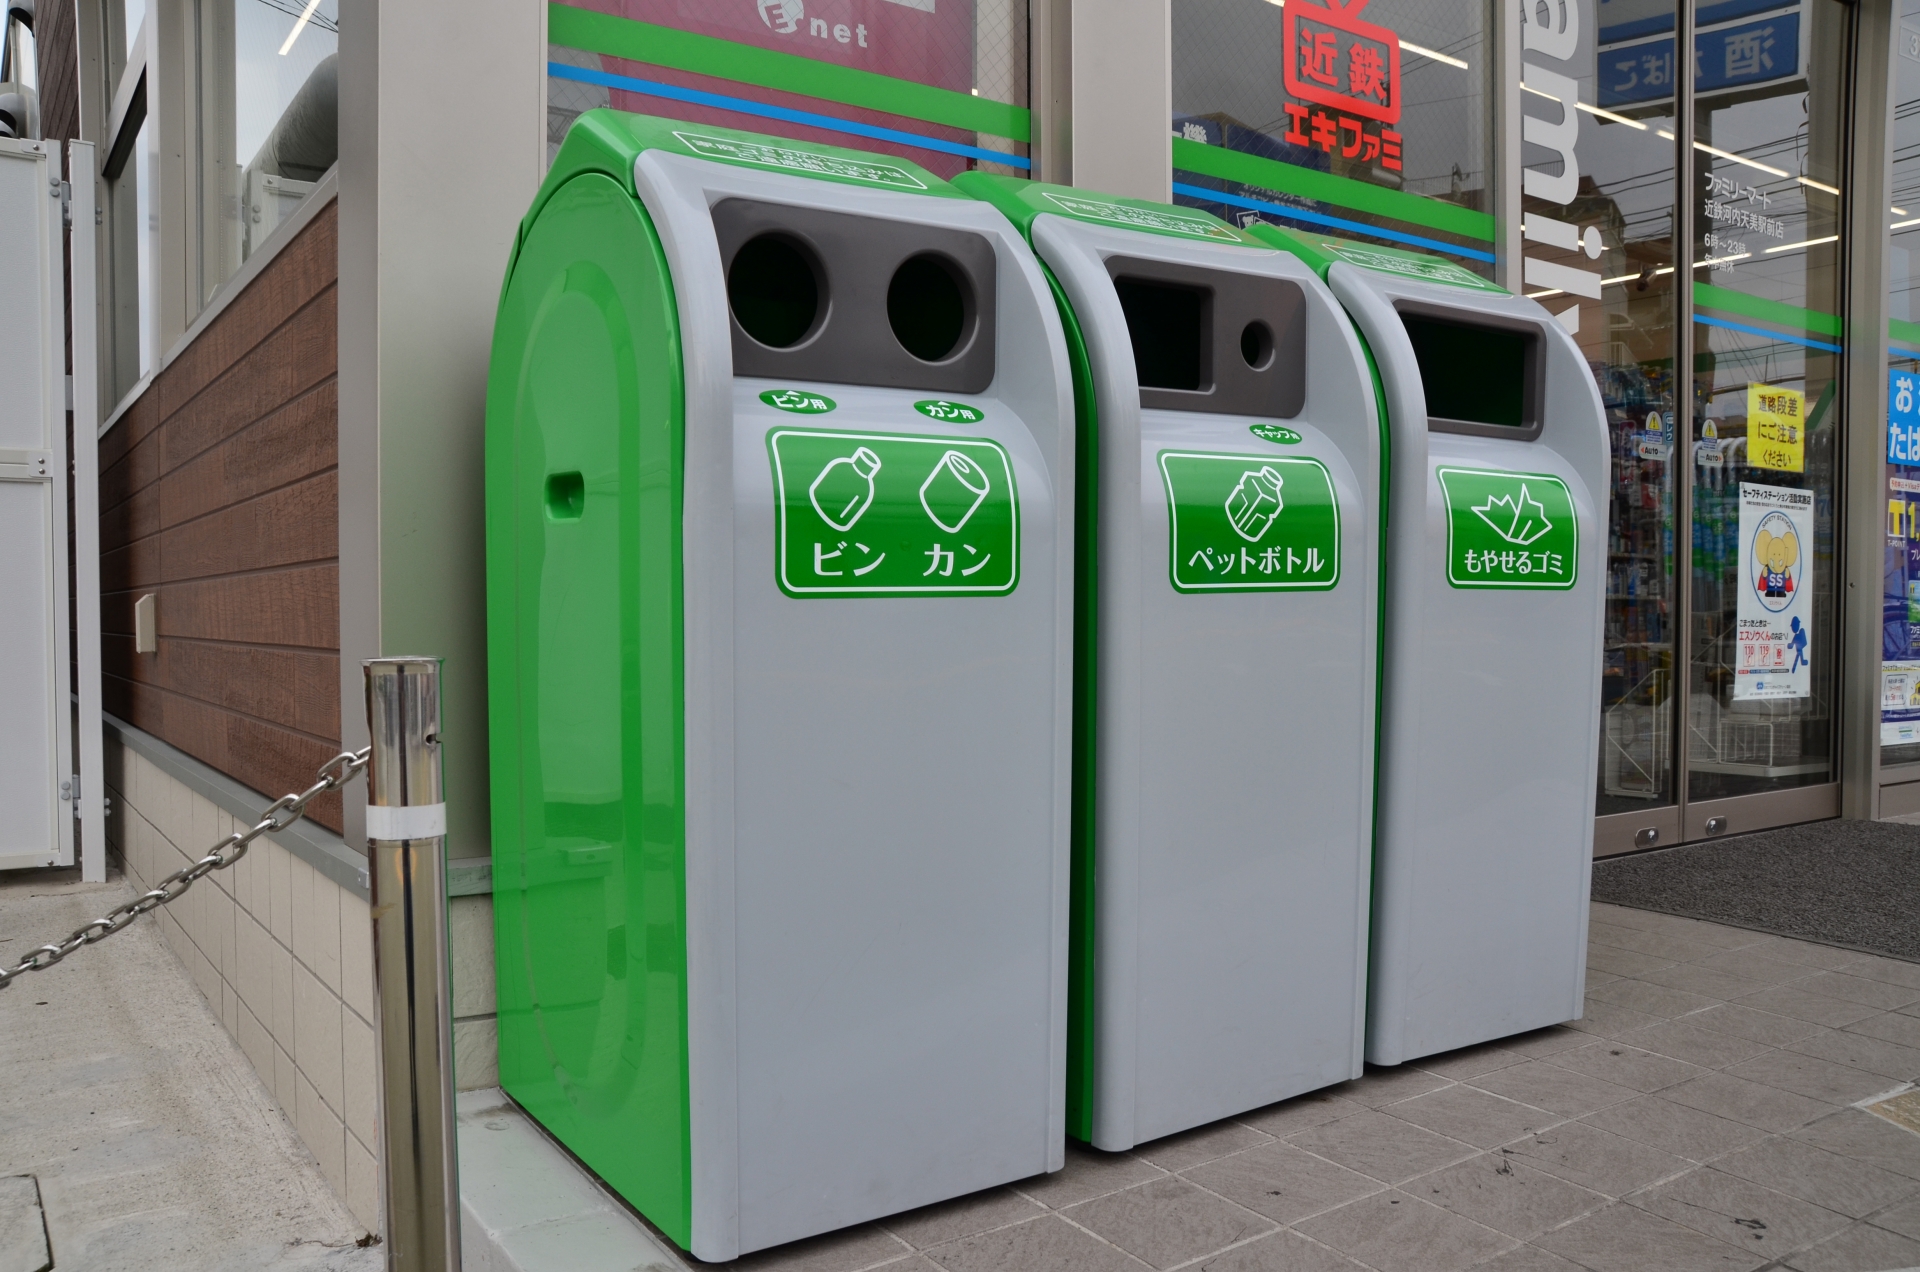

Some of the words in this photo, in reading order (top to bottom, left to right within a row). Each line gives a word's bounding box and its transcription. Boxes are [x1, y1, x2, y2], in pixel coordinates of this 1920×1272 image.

[810, 17, 868, 48] net
[1301, 27, 1387, 100] 近鉄
[1284, 102, 1403, 171] エキファミ
[1704, 172, 1771, 210] ファミリーマート
[1704, 198, 1784, 239] 近鉄河内天美駅前店
[771, 392, 828, 410] ビン用
[1758, 395, 1798, 417] 道路段差
[1895, 376, 1920, 414] お
[926, 402, 976, 421] カン用
[1758, 421, 1798, 444] にご注意
[1644, 446, 1658, 455] Auto
[1705, 453, 1718, 462] Auto
[1762, 449, 1792, 468] ください
[1742, 488, 1812, 505] セーフティステーション活動実施店
[1762, 515, 1776, 528] SAFETY
[814, 540, 886, 577] ビン
[922, 543, 991, 577] カン
[1188, 546, 1325, 575] ペットボトル
[1464, 549, 1563, 575] もやせるゴミ
[1769, 573, 1784, 586] SS
[1744, 645, 1754, 655] 110
[1760, 645, 1769, 655] 119
